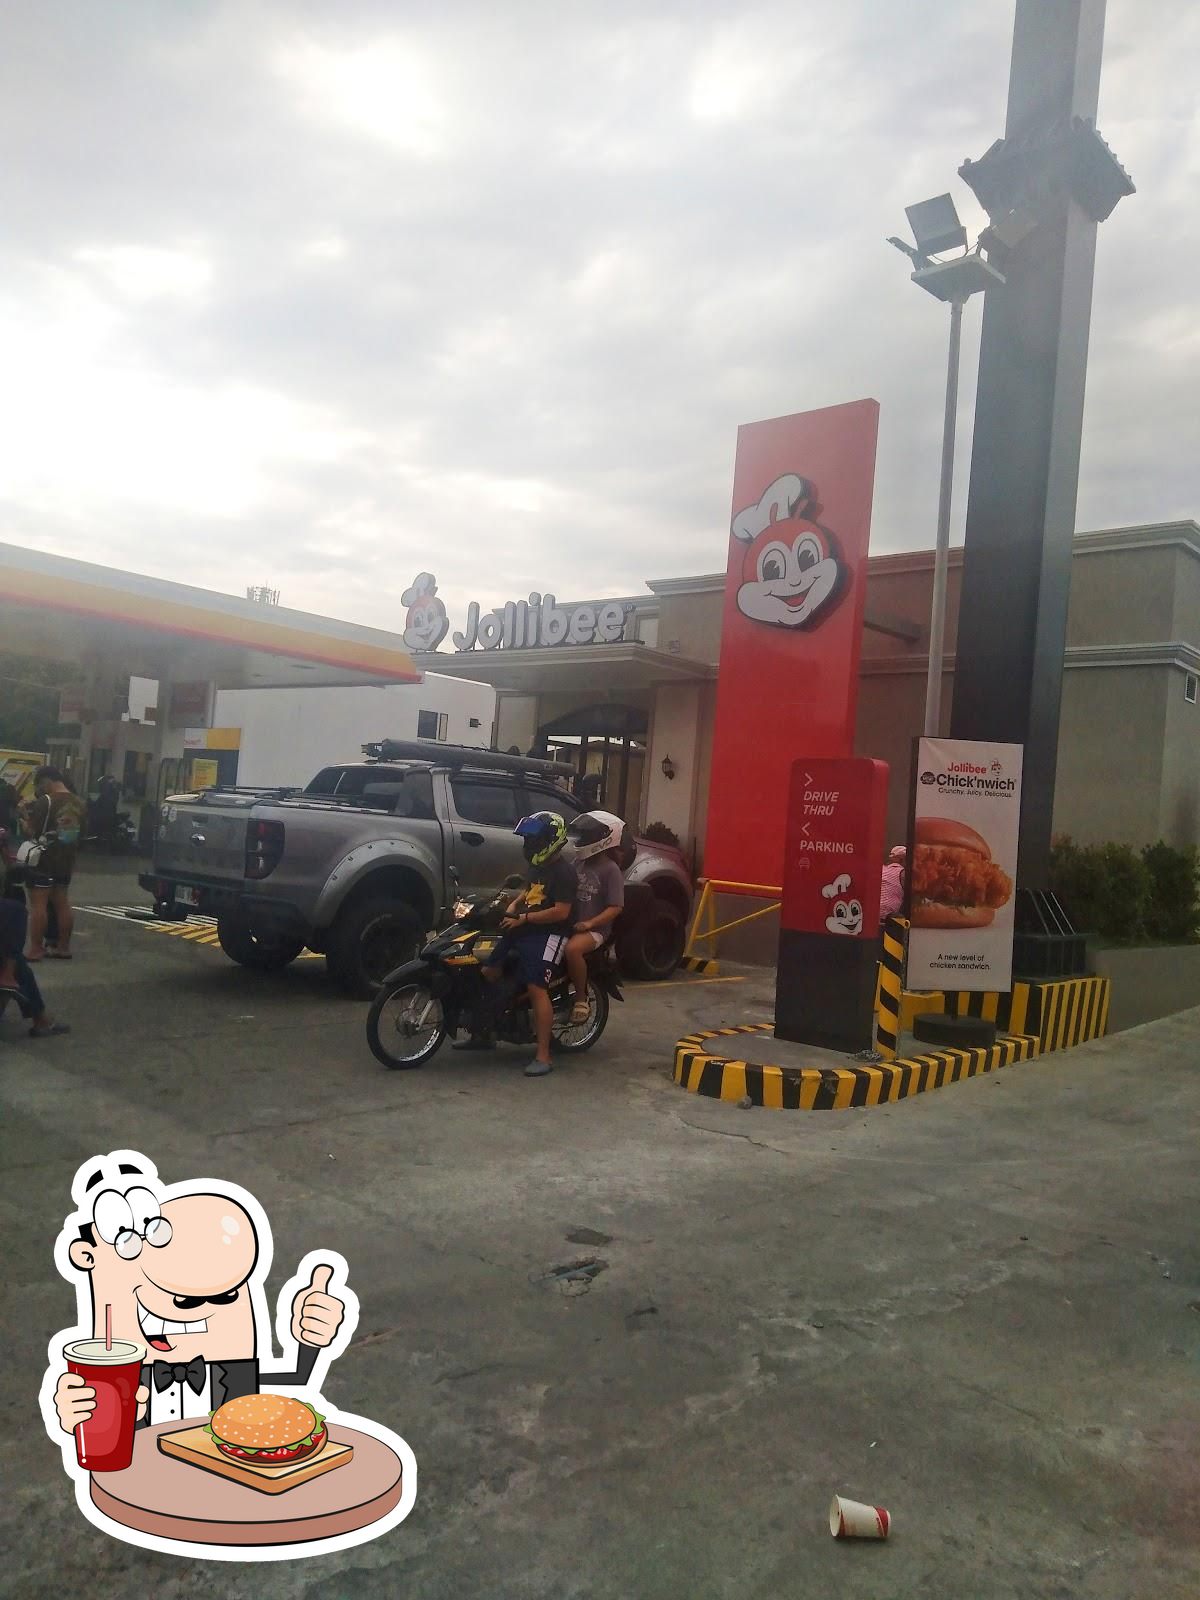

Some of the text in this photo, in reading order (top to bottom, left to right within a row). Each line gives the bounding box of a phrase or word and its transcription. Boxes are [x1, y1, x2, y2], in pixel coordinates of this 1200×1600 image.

[453, 592, 625, 650] Jollibee
[947, 762, 987, 774] Jollibee
[937, 774, 1015, 790] Chick'nwich
[803, 791, 840, 802] DRIVE
[803, 804, 834, 816] THRU
[800, 840, 854, 854] PARKING
